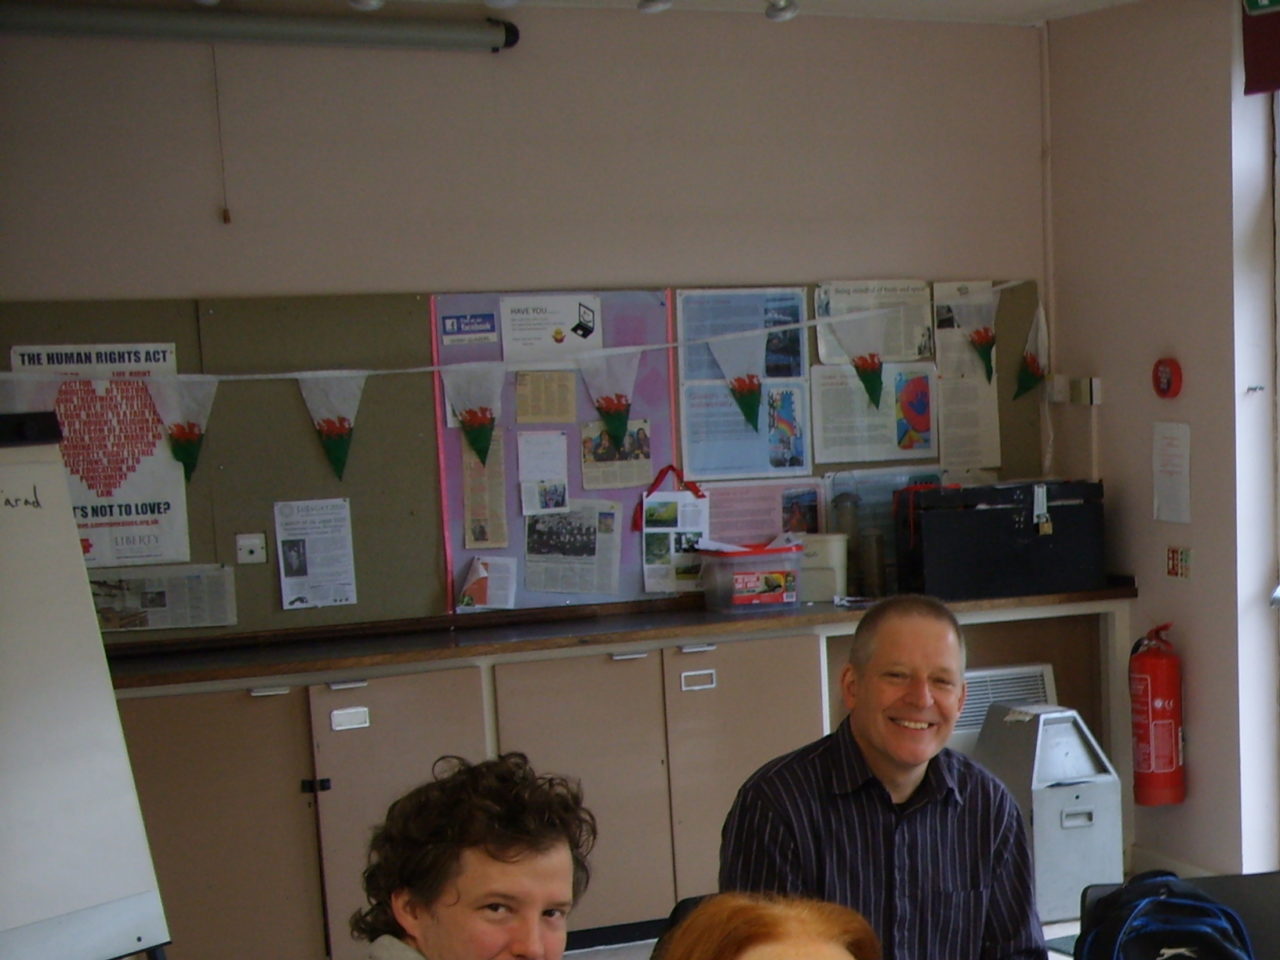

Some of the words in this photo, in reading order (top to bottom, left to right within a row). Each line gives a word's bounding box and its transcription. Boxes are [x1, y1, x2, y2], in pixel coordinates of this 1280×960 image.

[510, 306, 530, 315] HAVE
[19, 352, 43, 366] THE
[46, 351, 92, 365] HUMAN
[95, 349, 141, 364] RIGHTS
[144, 349, 168, 363] ACT
[4, 484, 42, 509] arad
[91, 504, 115, 518] NOT
[117, 503, 133, 517] TO
[135, 501, 171, 516] LOVE?
[115, 535, 160, 546] LIBERTY
